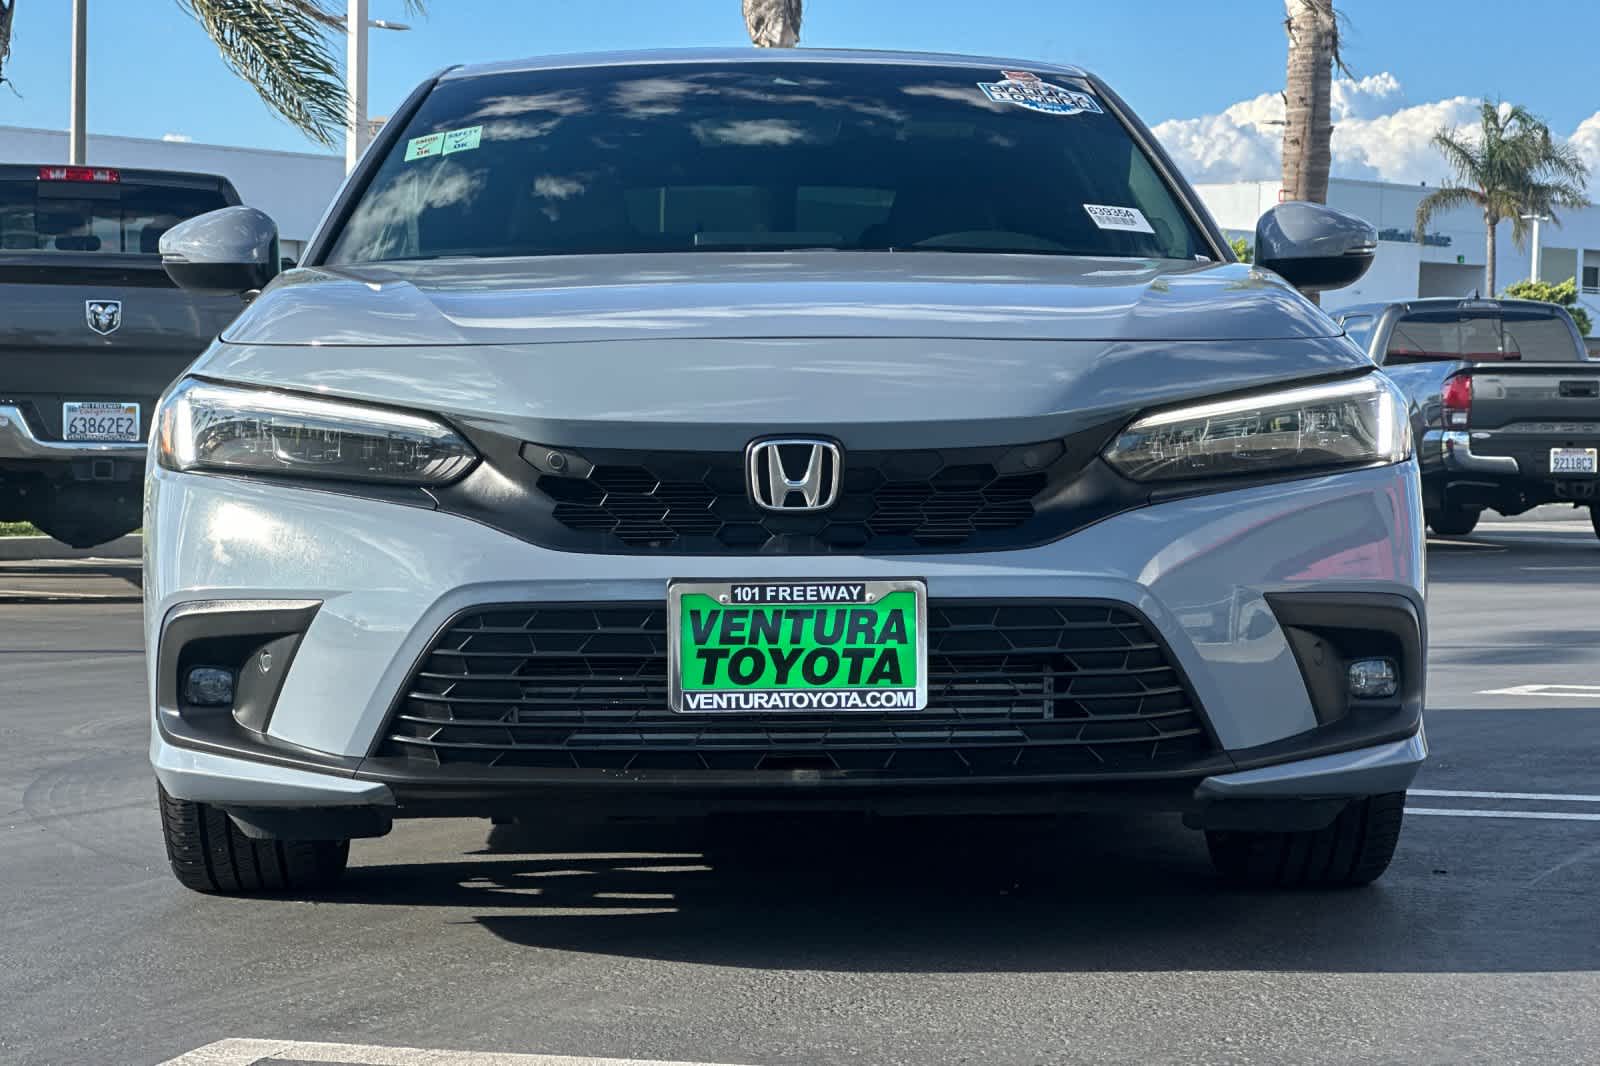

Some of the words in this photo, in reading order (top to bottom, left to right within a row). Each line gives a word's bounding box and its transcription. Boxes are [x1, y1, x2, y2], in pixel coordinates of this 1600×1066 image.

[1087, 206, 1136, 218] 63935A
[69, 417, 134, 435] 63862E2
[734, 587, 760, 602] 101
[766, 586, 862, 601] FREEWAY
[689, 608, 909, 646] VENTURA
[696, 647, 903, 686] TOYOTA
[686, 691, 914, 709] VENTURATOYOTA.COM
